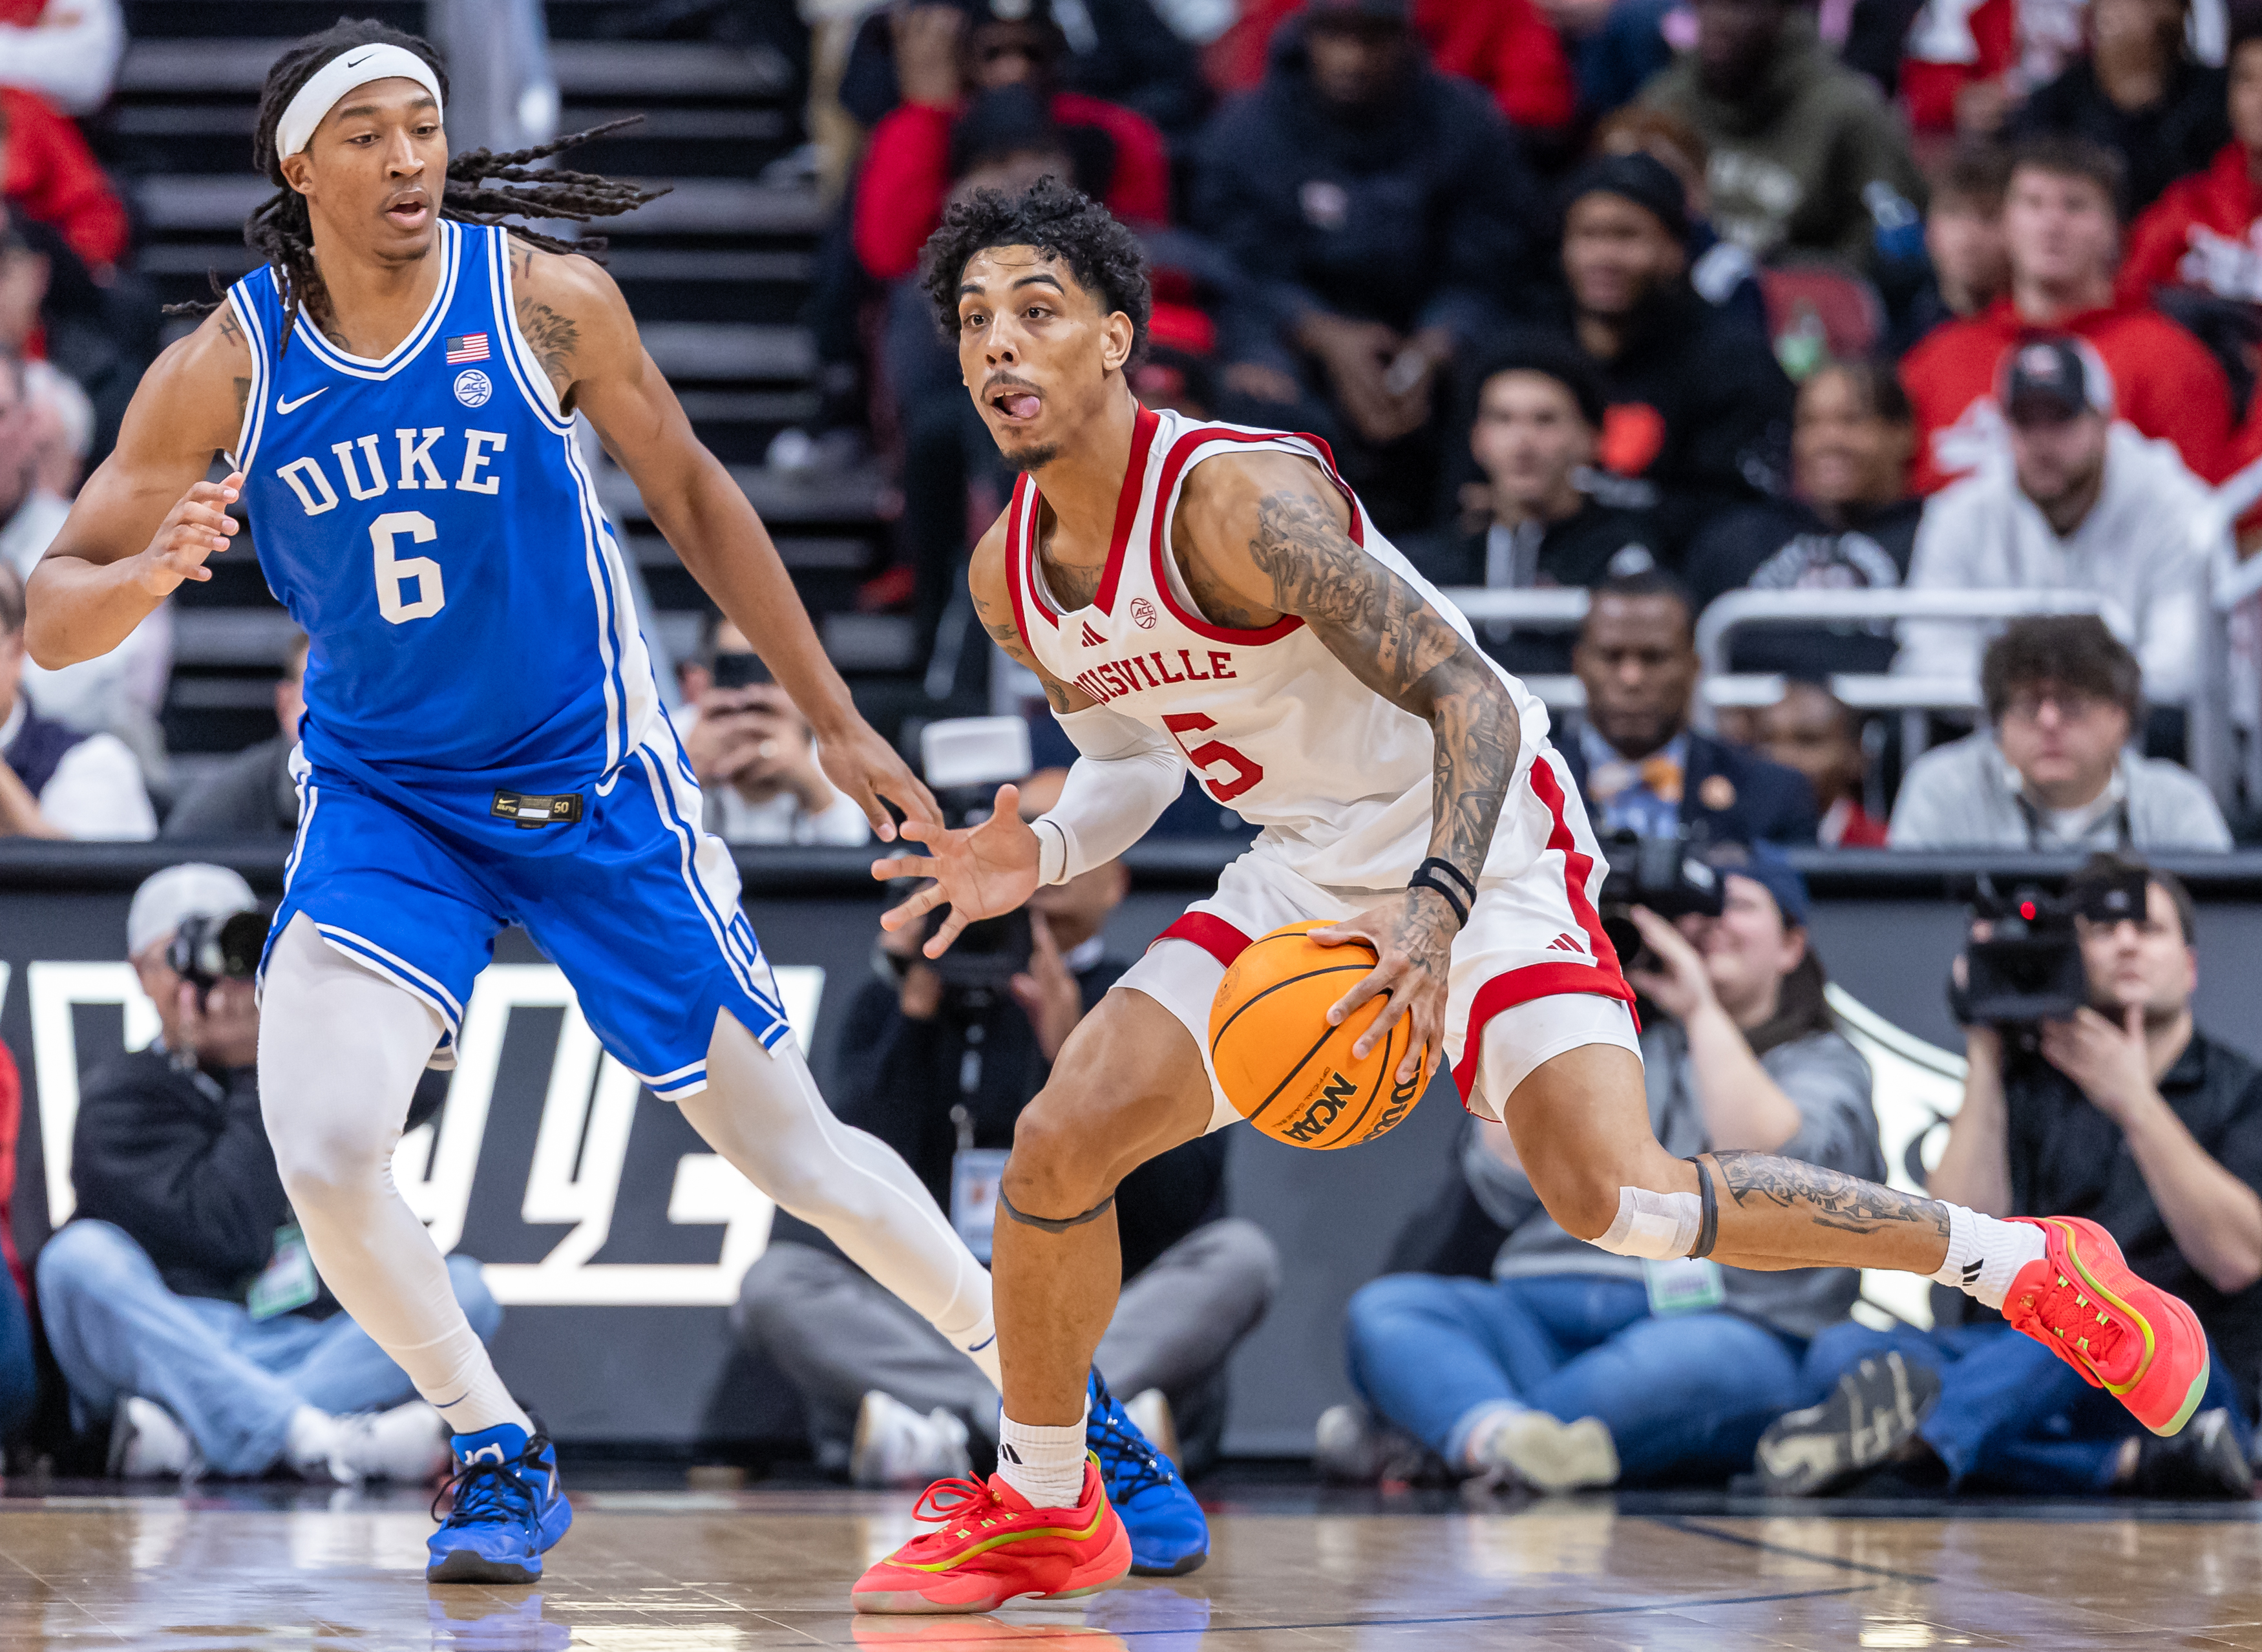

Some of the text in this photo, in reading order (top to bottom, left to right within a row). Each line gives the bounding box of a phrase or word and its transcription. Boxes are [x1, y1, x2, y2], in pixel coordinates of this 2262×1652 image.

[461, 381, 487, 391] ACC
[277, 427, 507, 516] DUKE
[368, 511, 445, 624] 6
[1135, 605, 1154, 617] ACC
[1161, 712, 1263, 802] 5
[554, 801, 569, 813] 50
[1304, 1066, 1331, 1101] OFFICIAL
[1281, 1070, 1358, 1143] NCAA
[1285, 1102, 1305, 1120] GAME
